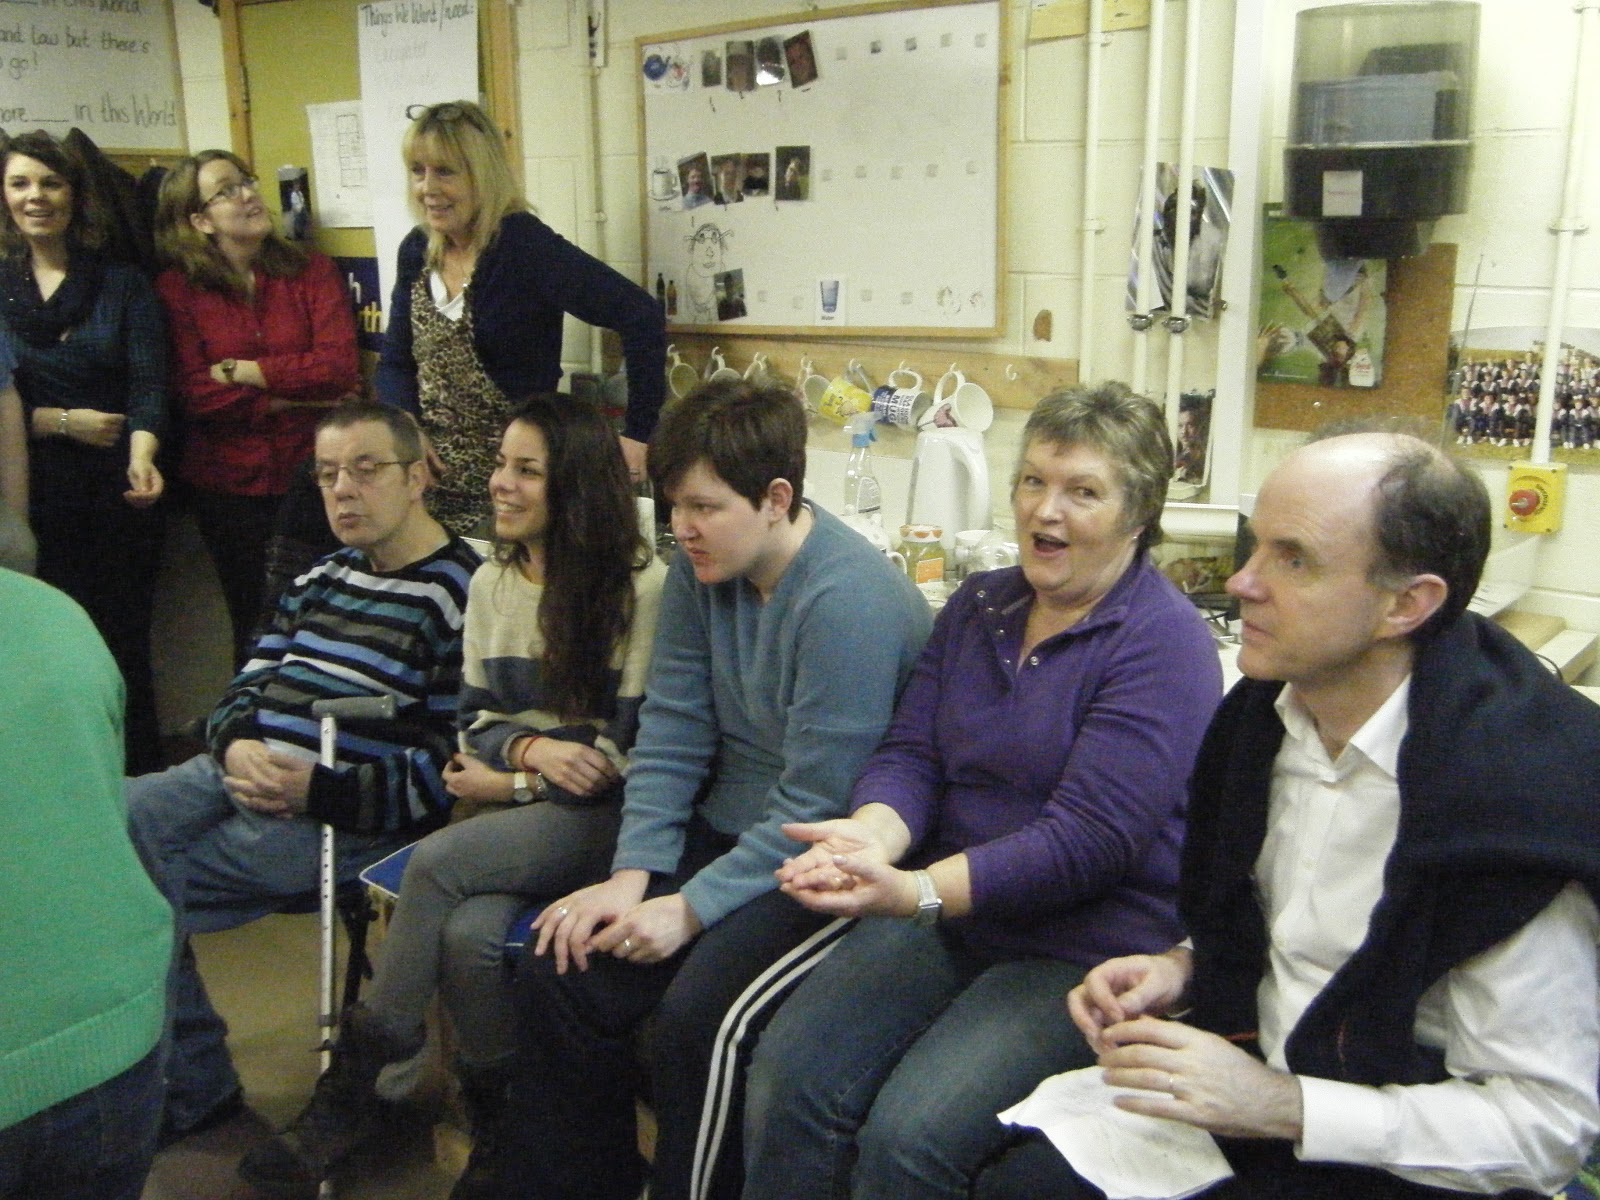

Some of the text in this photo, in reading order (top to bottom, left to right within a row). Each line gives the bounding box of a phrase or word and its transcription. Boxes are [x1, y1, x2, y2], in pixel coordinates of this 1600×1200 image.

[65, 25, 89, 48] but
[75, 104, 94, 123] in
[102, 92, 130, 123] this
